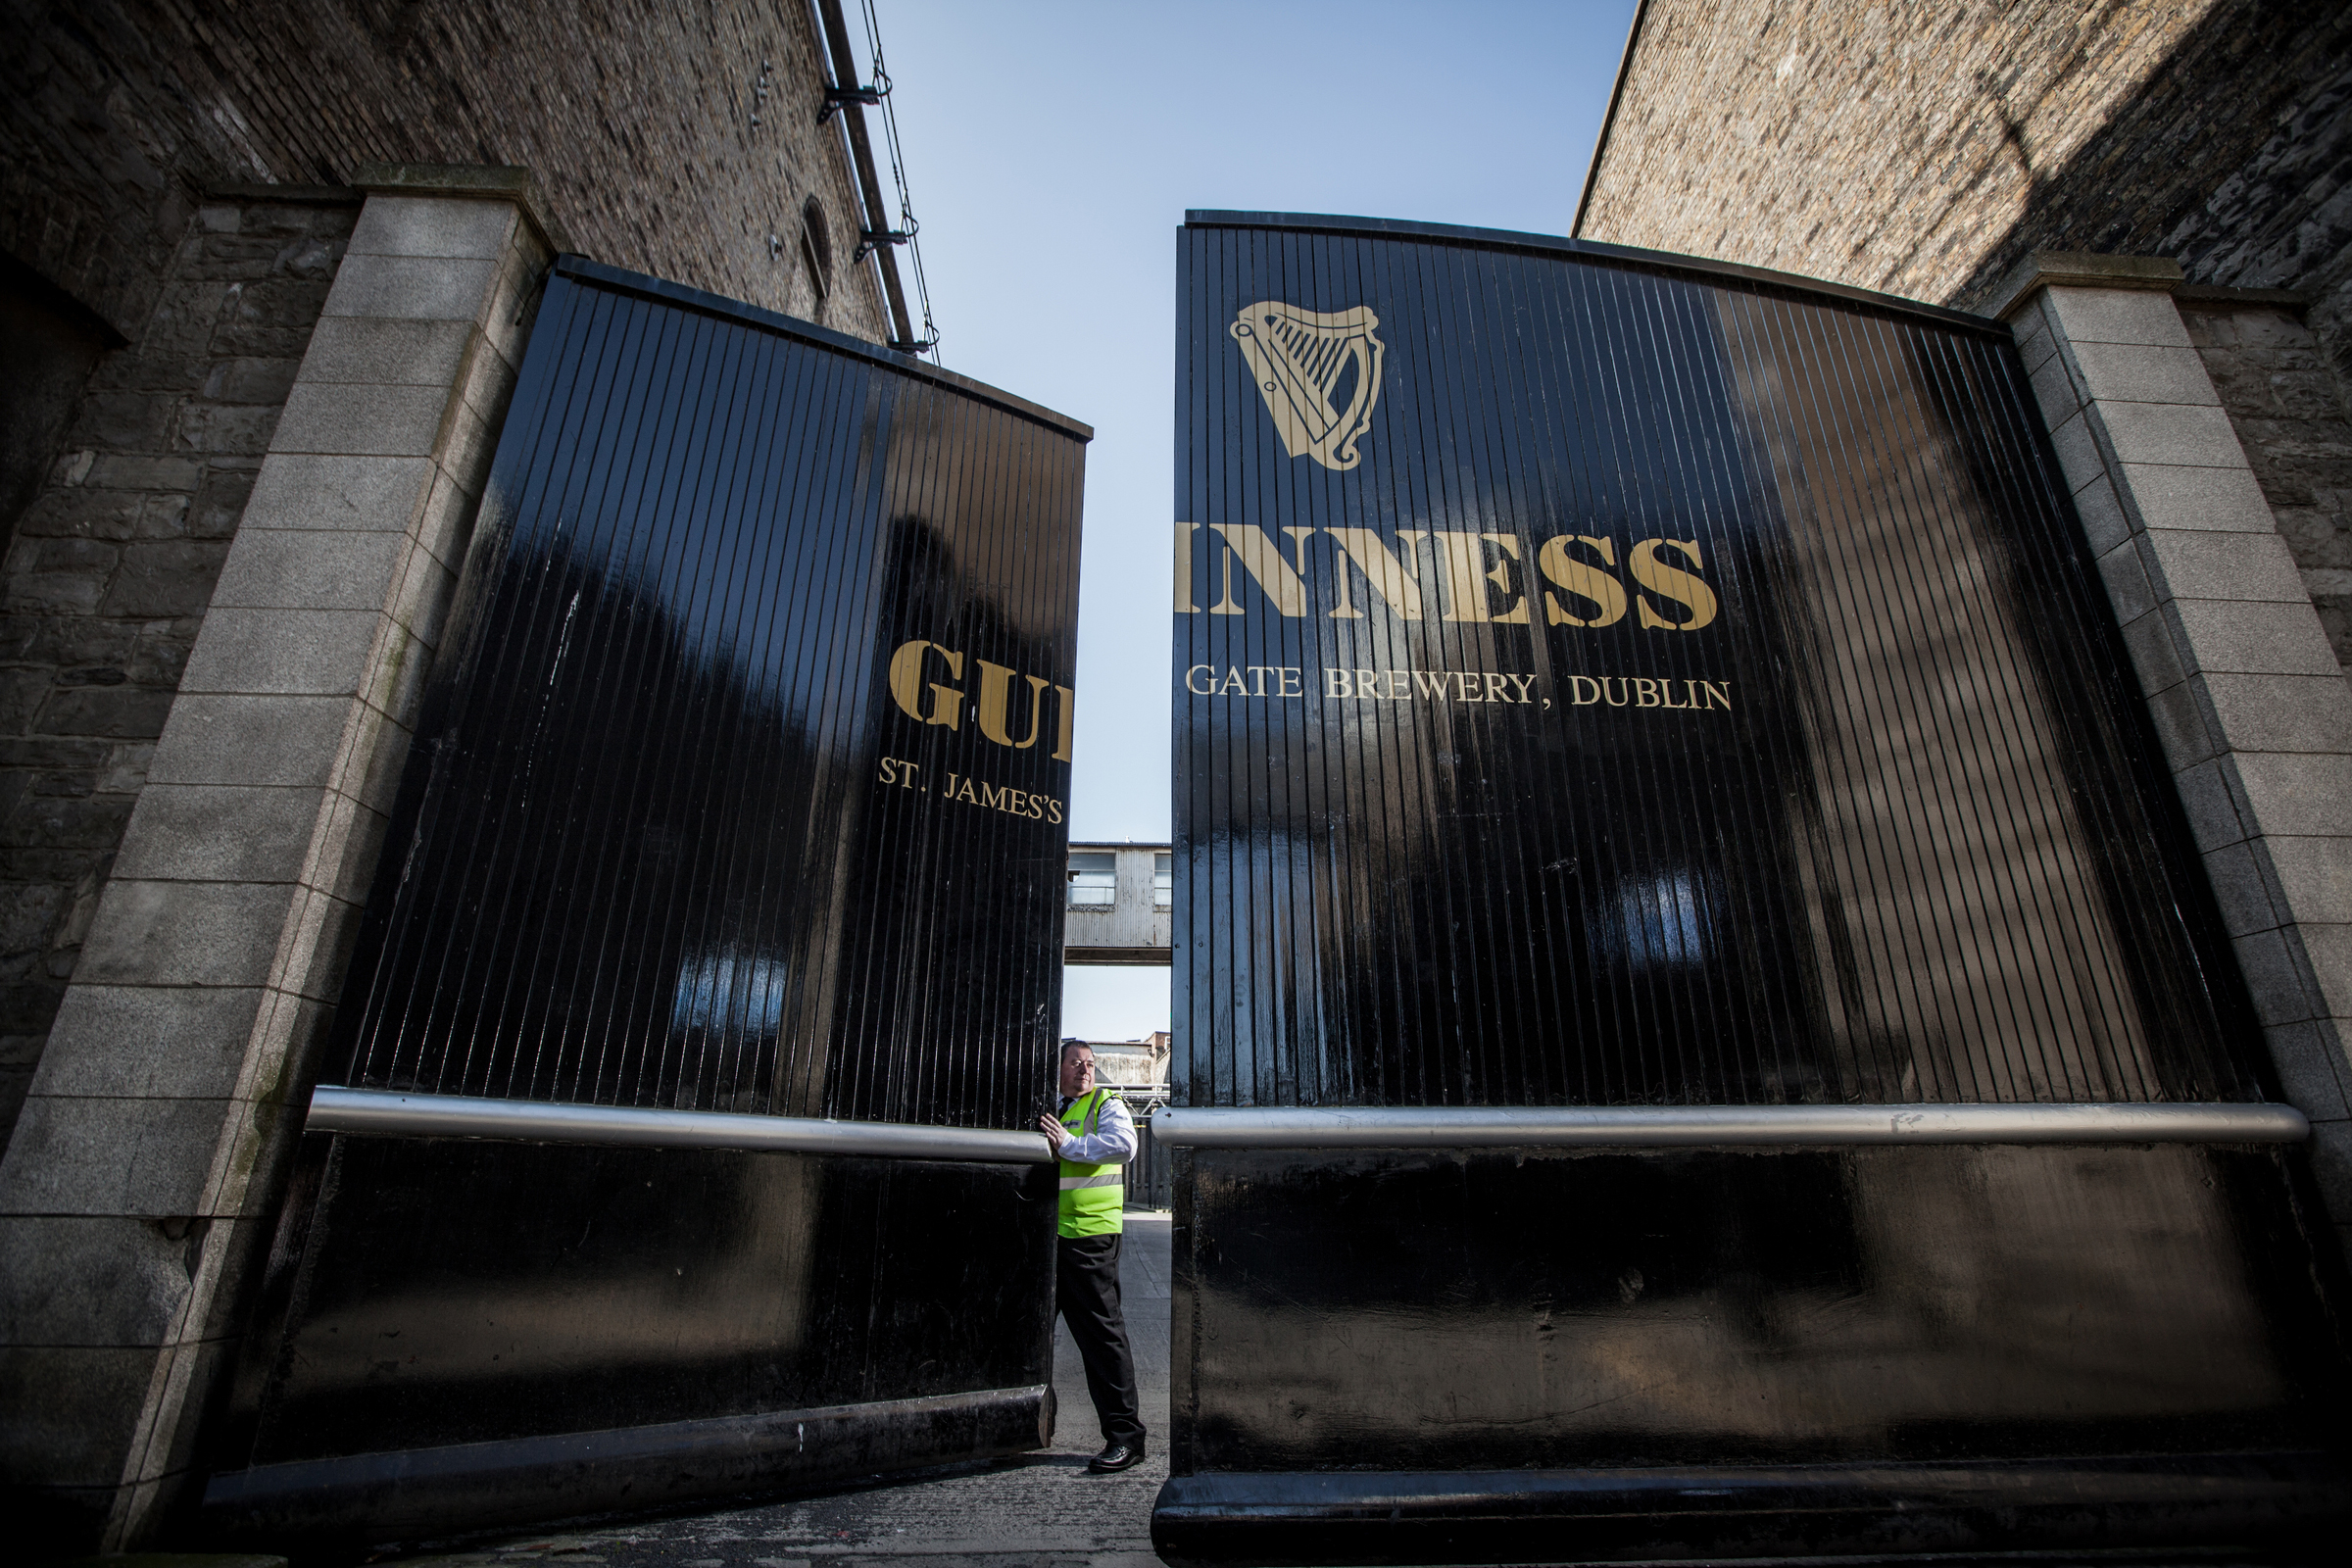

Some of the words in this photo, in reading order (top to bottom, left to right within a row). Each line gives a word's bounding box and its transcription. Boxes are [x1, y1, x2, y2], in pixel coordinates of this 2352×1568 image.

[1185, 664, 1303, 698] GATE
[1324, 667, 1551, 710] BREWERY,
[1567, 675, 1732, 711] DUBLIN
[878, 757, 926, 792] ST.
[944, 772, 1062, 824] JAMES'S
